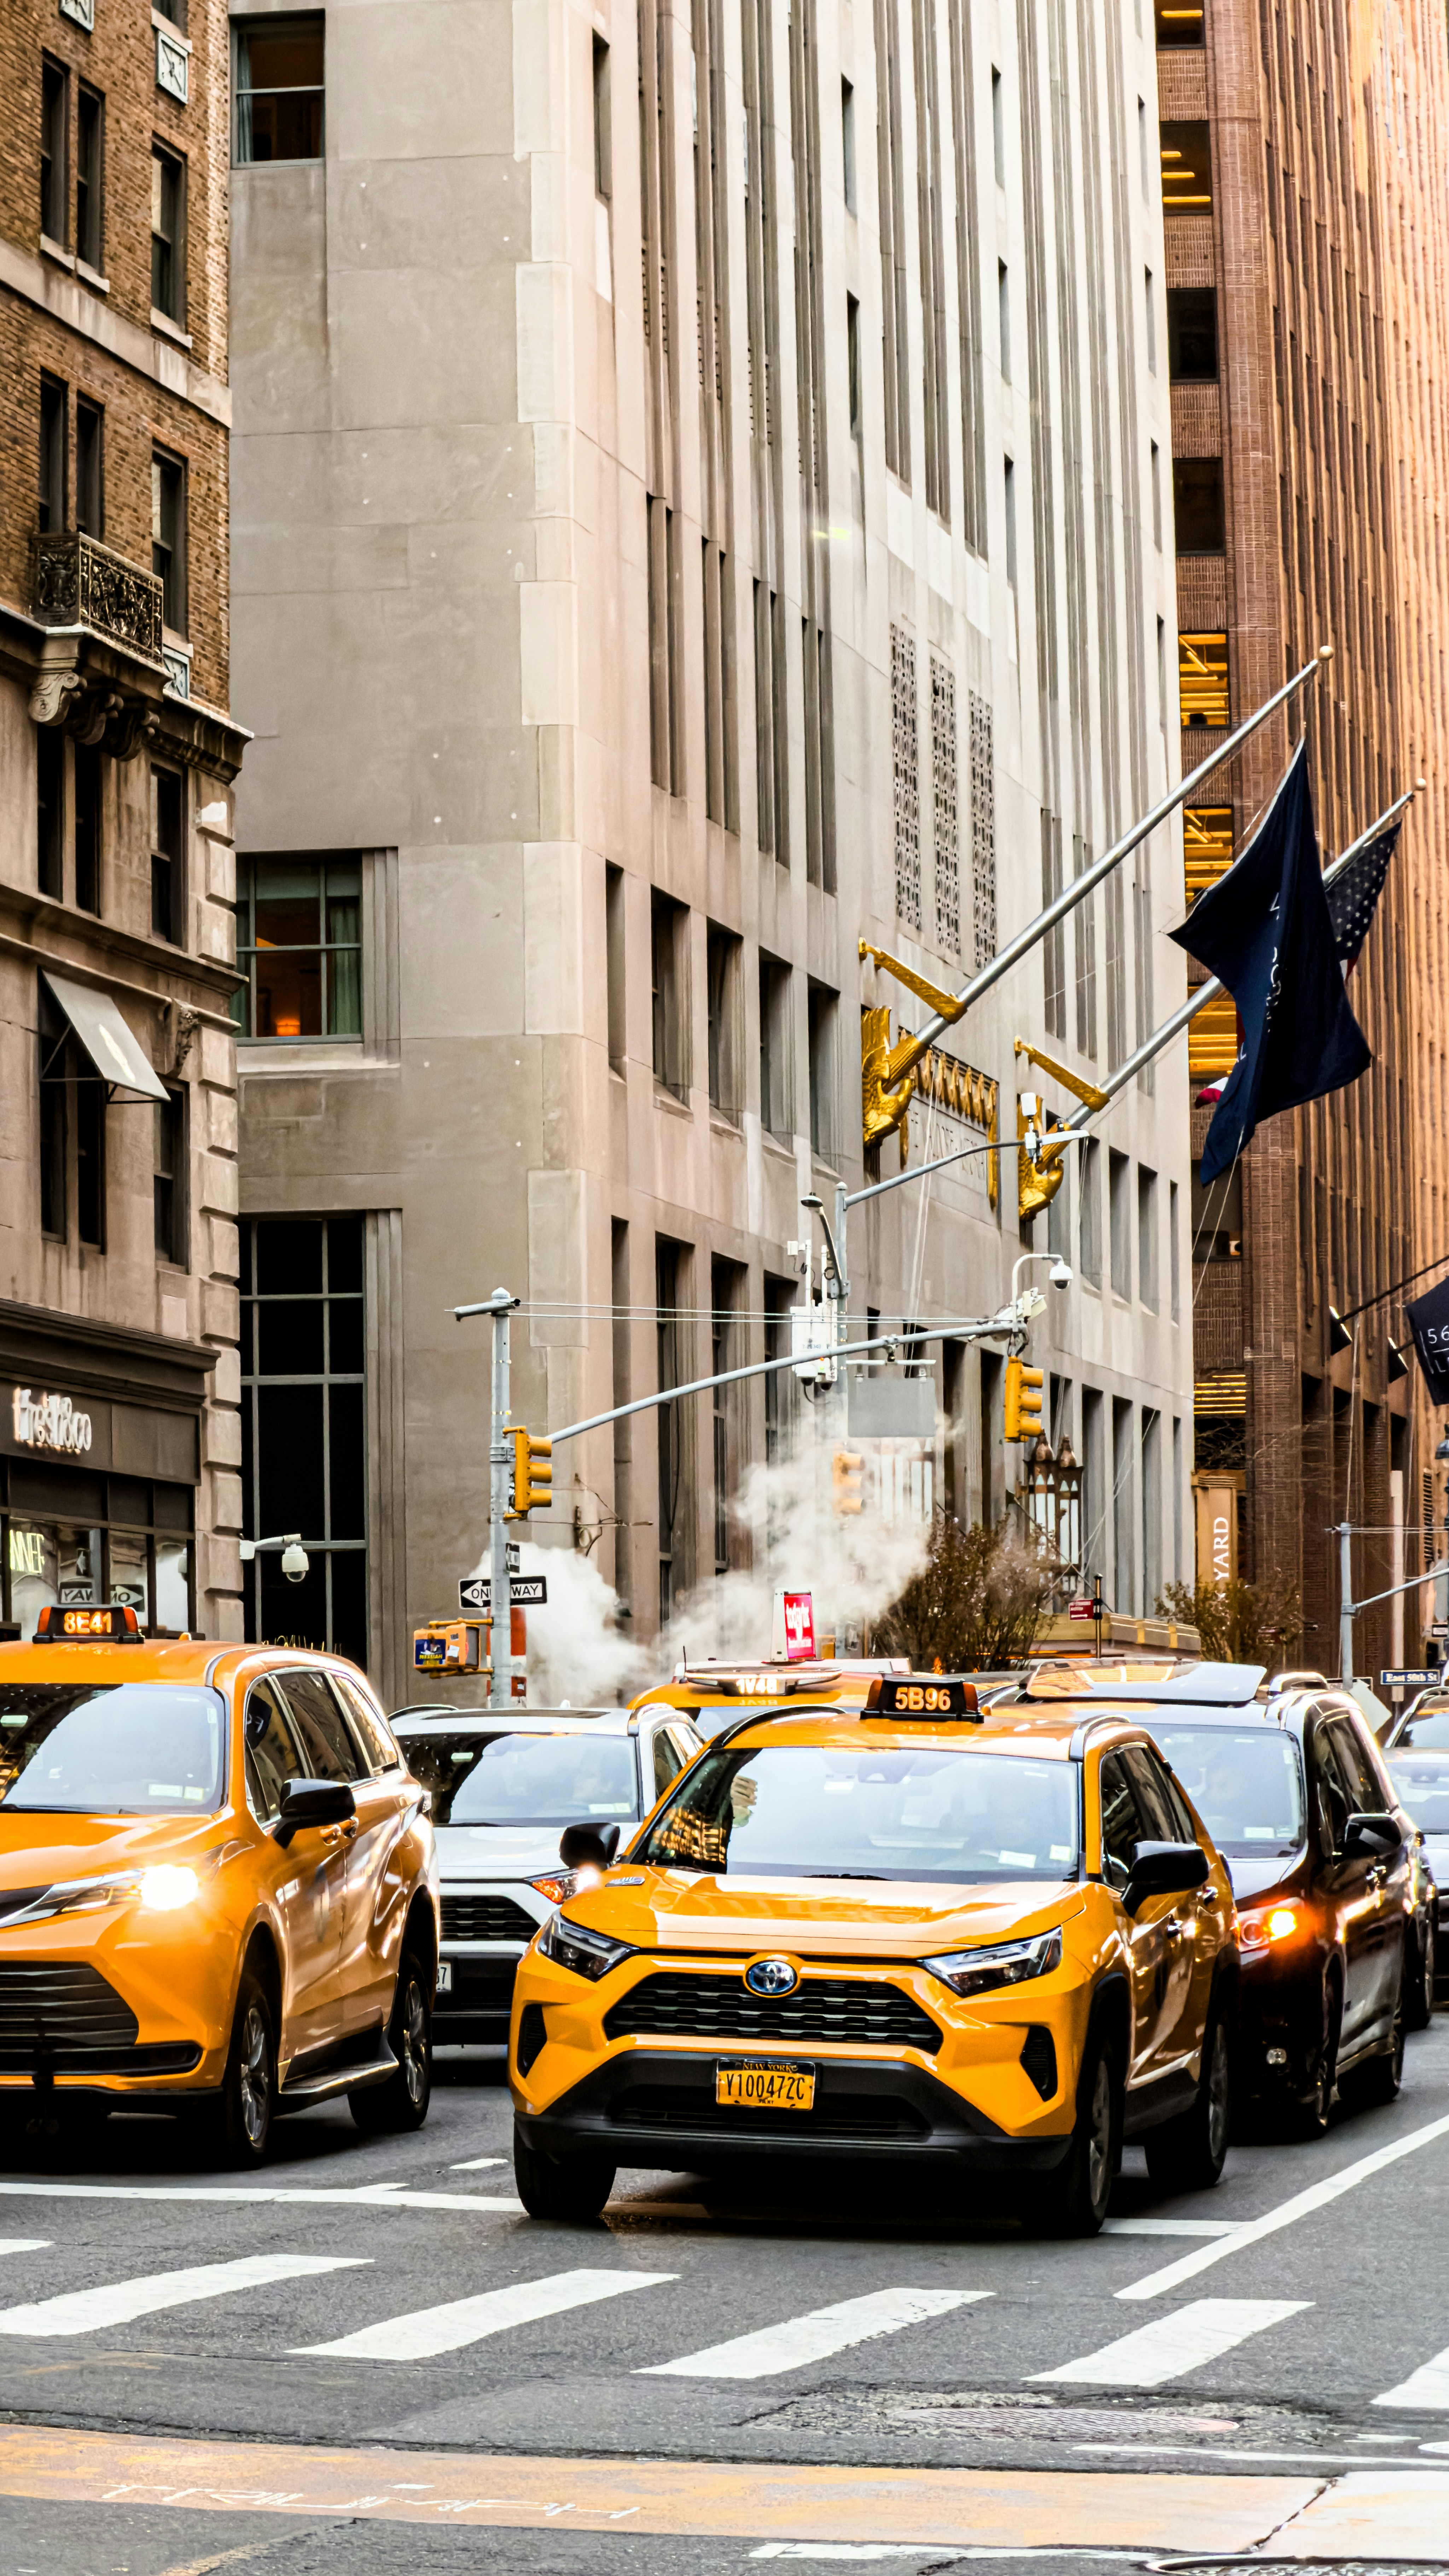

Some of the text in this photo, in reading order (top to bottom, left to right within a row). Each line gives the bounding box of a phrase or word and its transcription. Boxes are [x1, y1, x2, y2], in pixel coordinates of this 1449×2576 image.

[1213, 1517, 1229, 1581] YARD
[471, 1585, 539, 1599] ON WAY
[64, 1612, 112, 1634] 8E41
[736, 1678, 777, 1694] 1V48
[1427, 1673, 1438, 1681] St
[895, 1687, 951, 1710] 5B96
[768, 2064, 792, 2073] YORK
[726, 2073, 805, 2100] Y100472C
